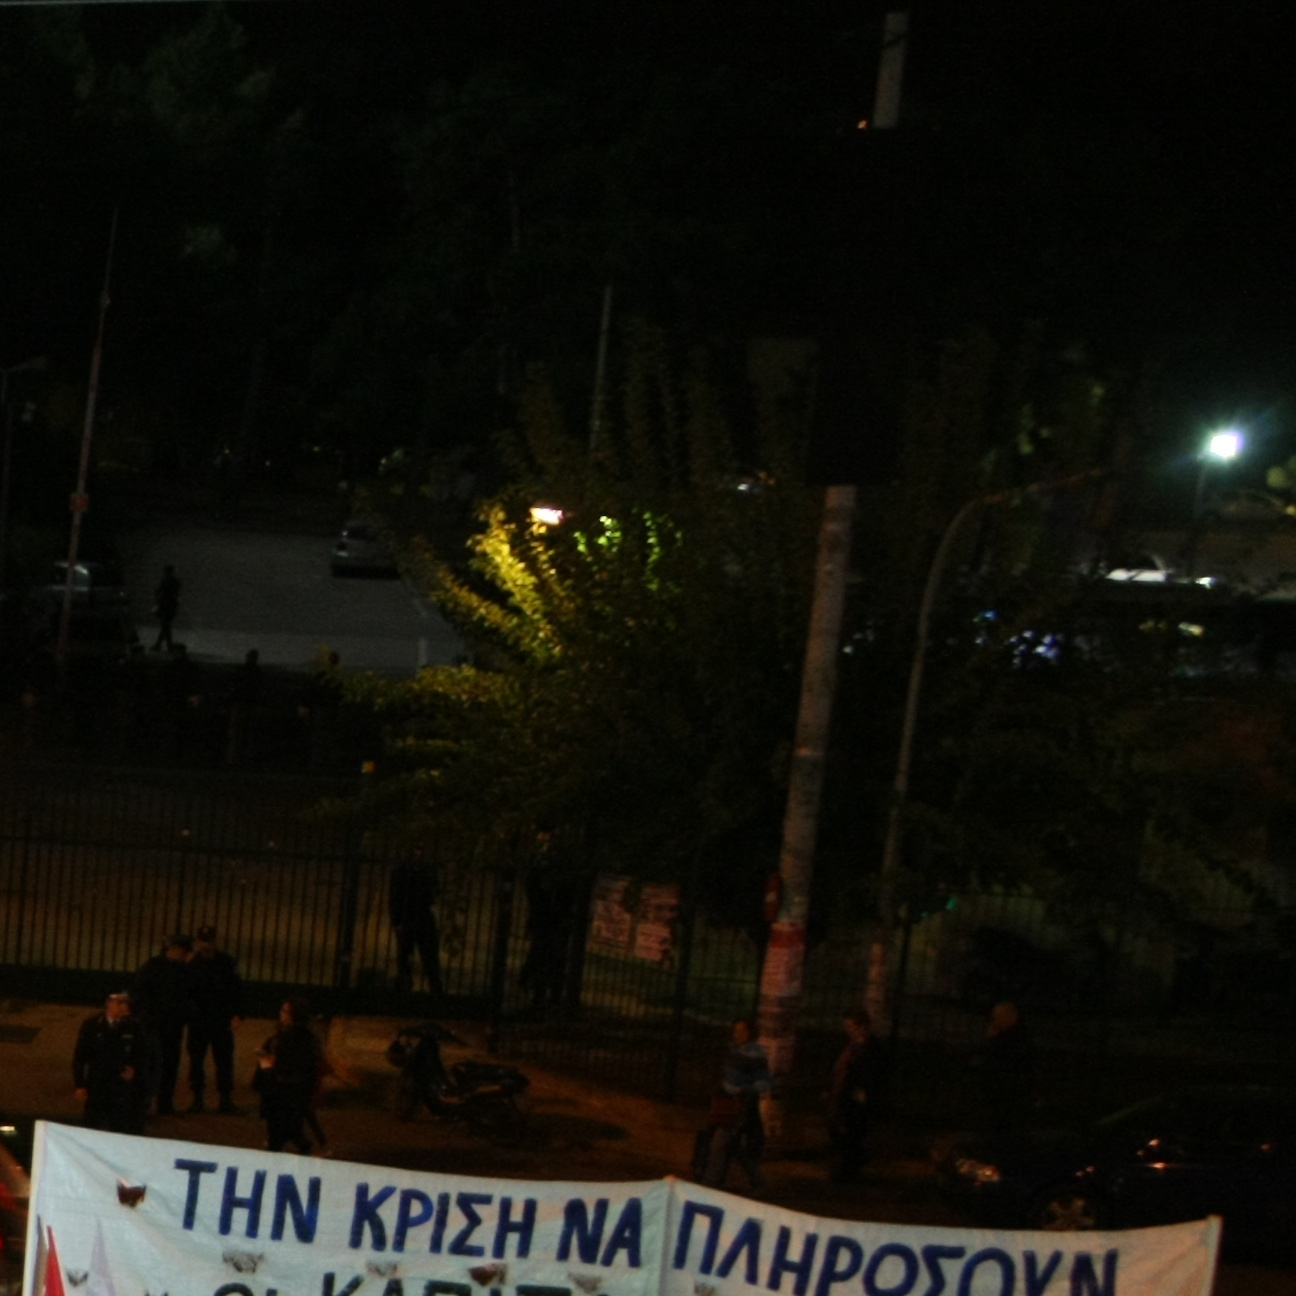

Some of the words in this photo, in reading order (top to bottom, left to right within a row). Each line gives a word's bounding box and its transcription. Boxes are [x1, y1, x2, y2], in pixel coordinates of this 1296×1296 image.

[173, 1157, 322, 1244] ΤΗΝ
[348, 1181, 538, 1259] ΚΡΙΣΗ
[555, 1197, 643, 1268] ΝΑ
